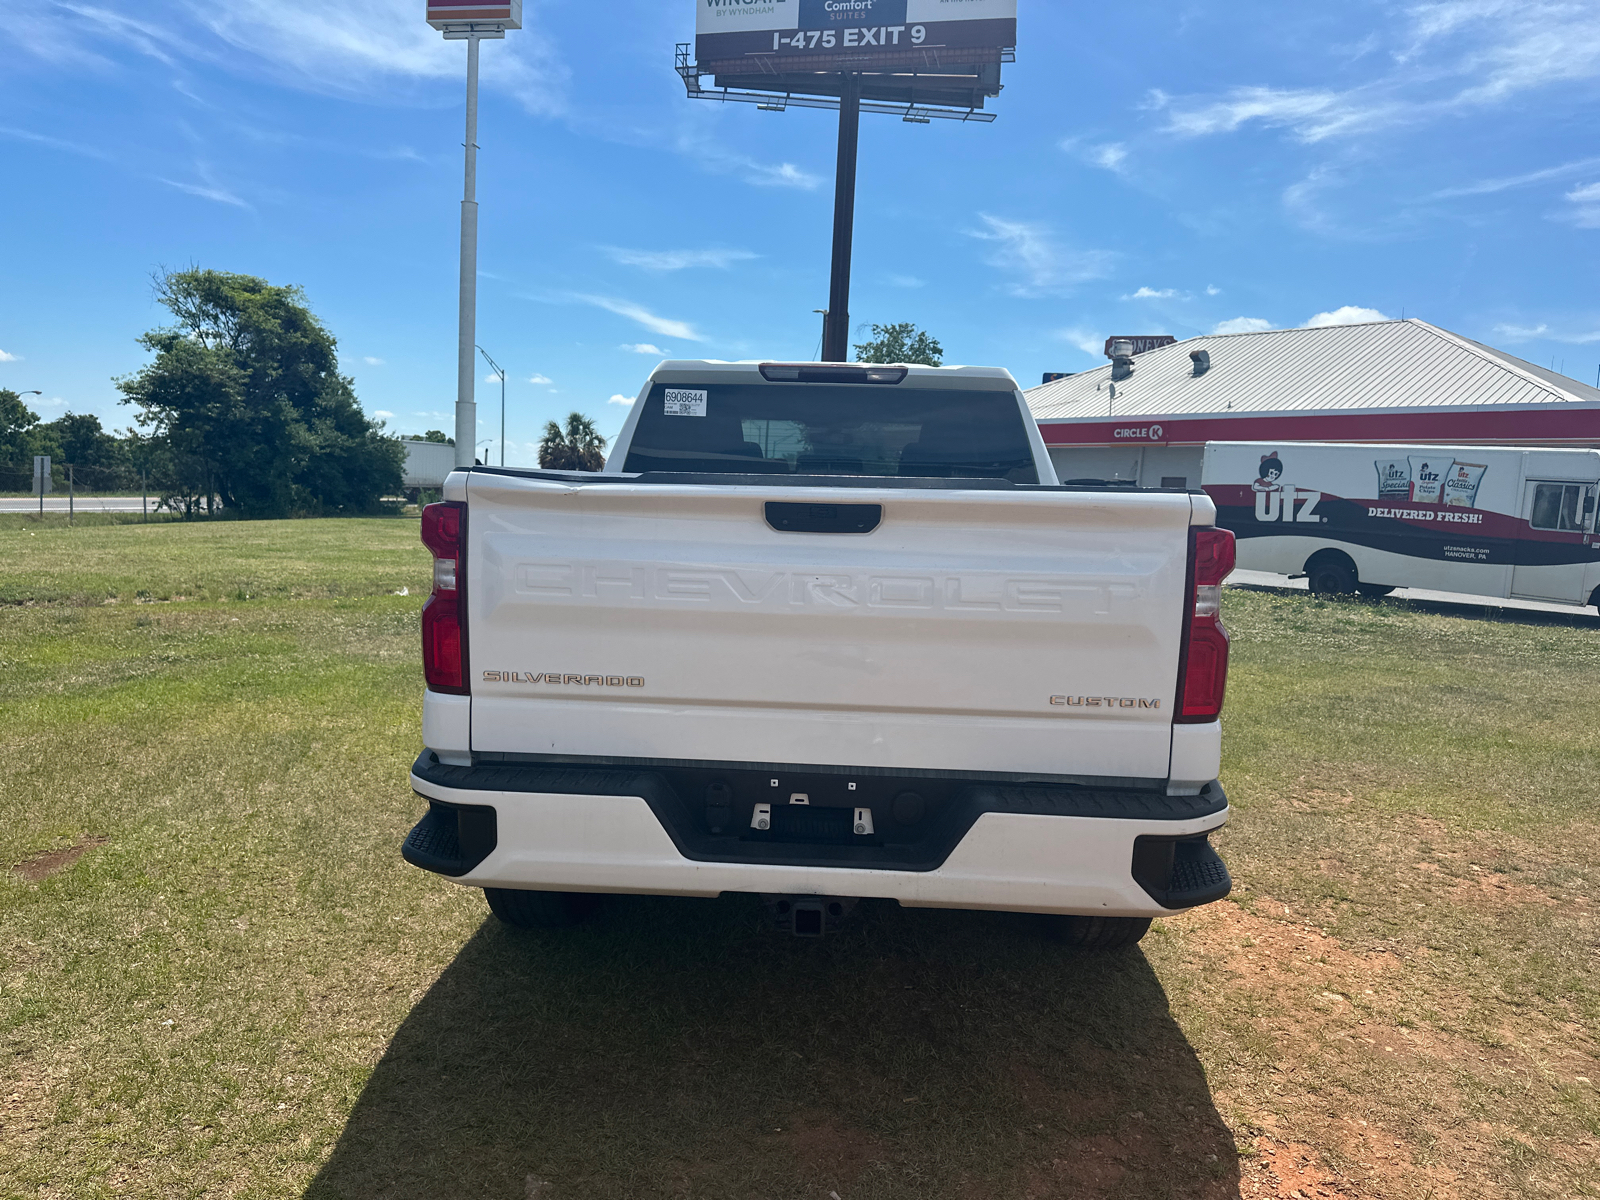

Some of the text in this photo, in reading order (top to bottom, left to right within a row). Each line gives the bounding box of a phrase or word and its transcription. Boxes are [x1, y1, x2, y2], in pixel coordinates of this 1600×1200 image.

[824, 0, 872, 11] Comfort
[716, 6, 775, 17] BY WYNDHAM
[829, 11, 866, 20] SUITES
[773, 25, 926, 50] I-475 EXIT 9
[665, 391, 703, 403] 6908644
[1114, 428, 1147, 438] CIRCLE
[1447, 479, 1475, 490] Classics
[1368, 507, 1483, 524] DELIVERED FRESH!
[1443, 545, 1490, 554] utzsnacks.com
[515, 563, 1137, 614] CHEVROLET
[483, 670, 645, 687] SILVERADO
[1050, 695, 1160, 709] CUSTOM
